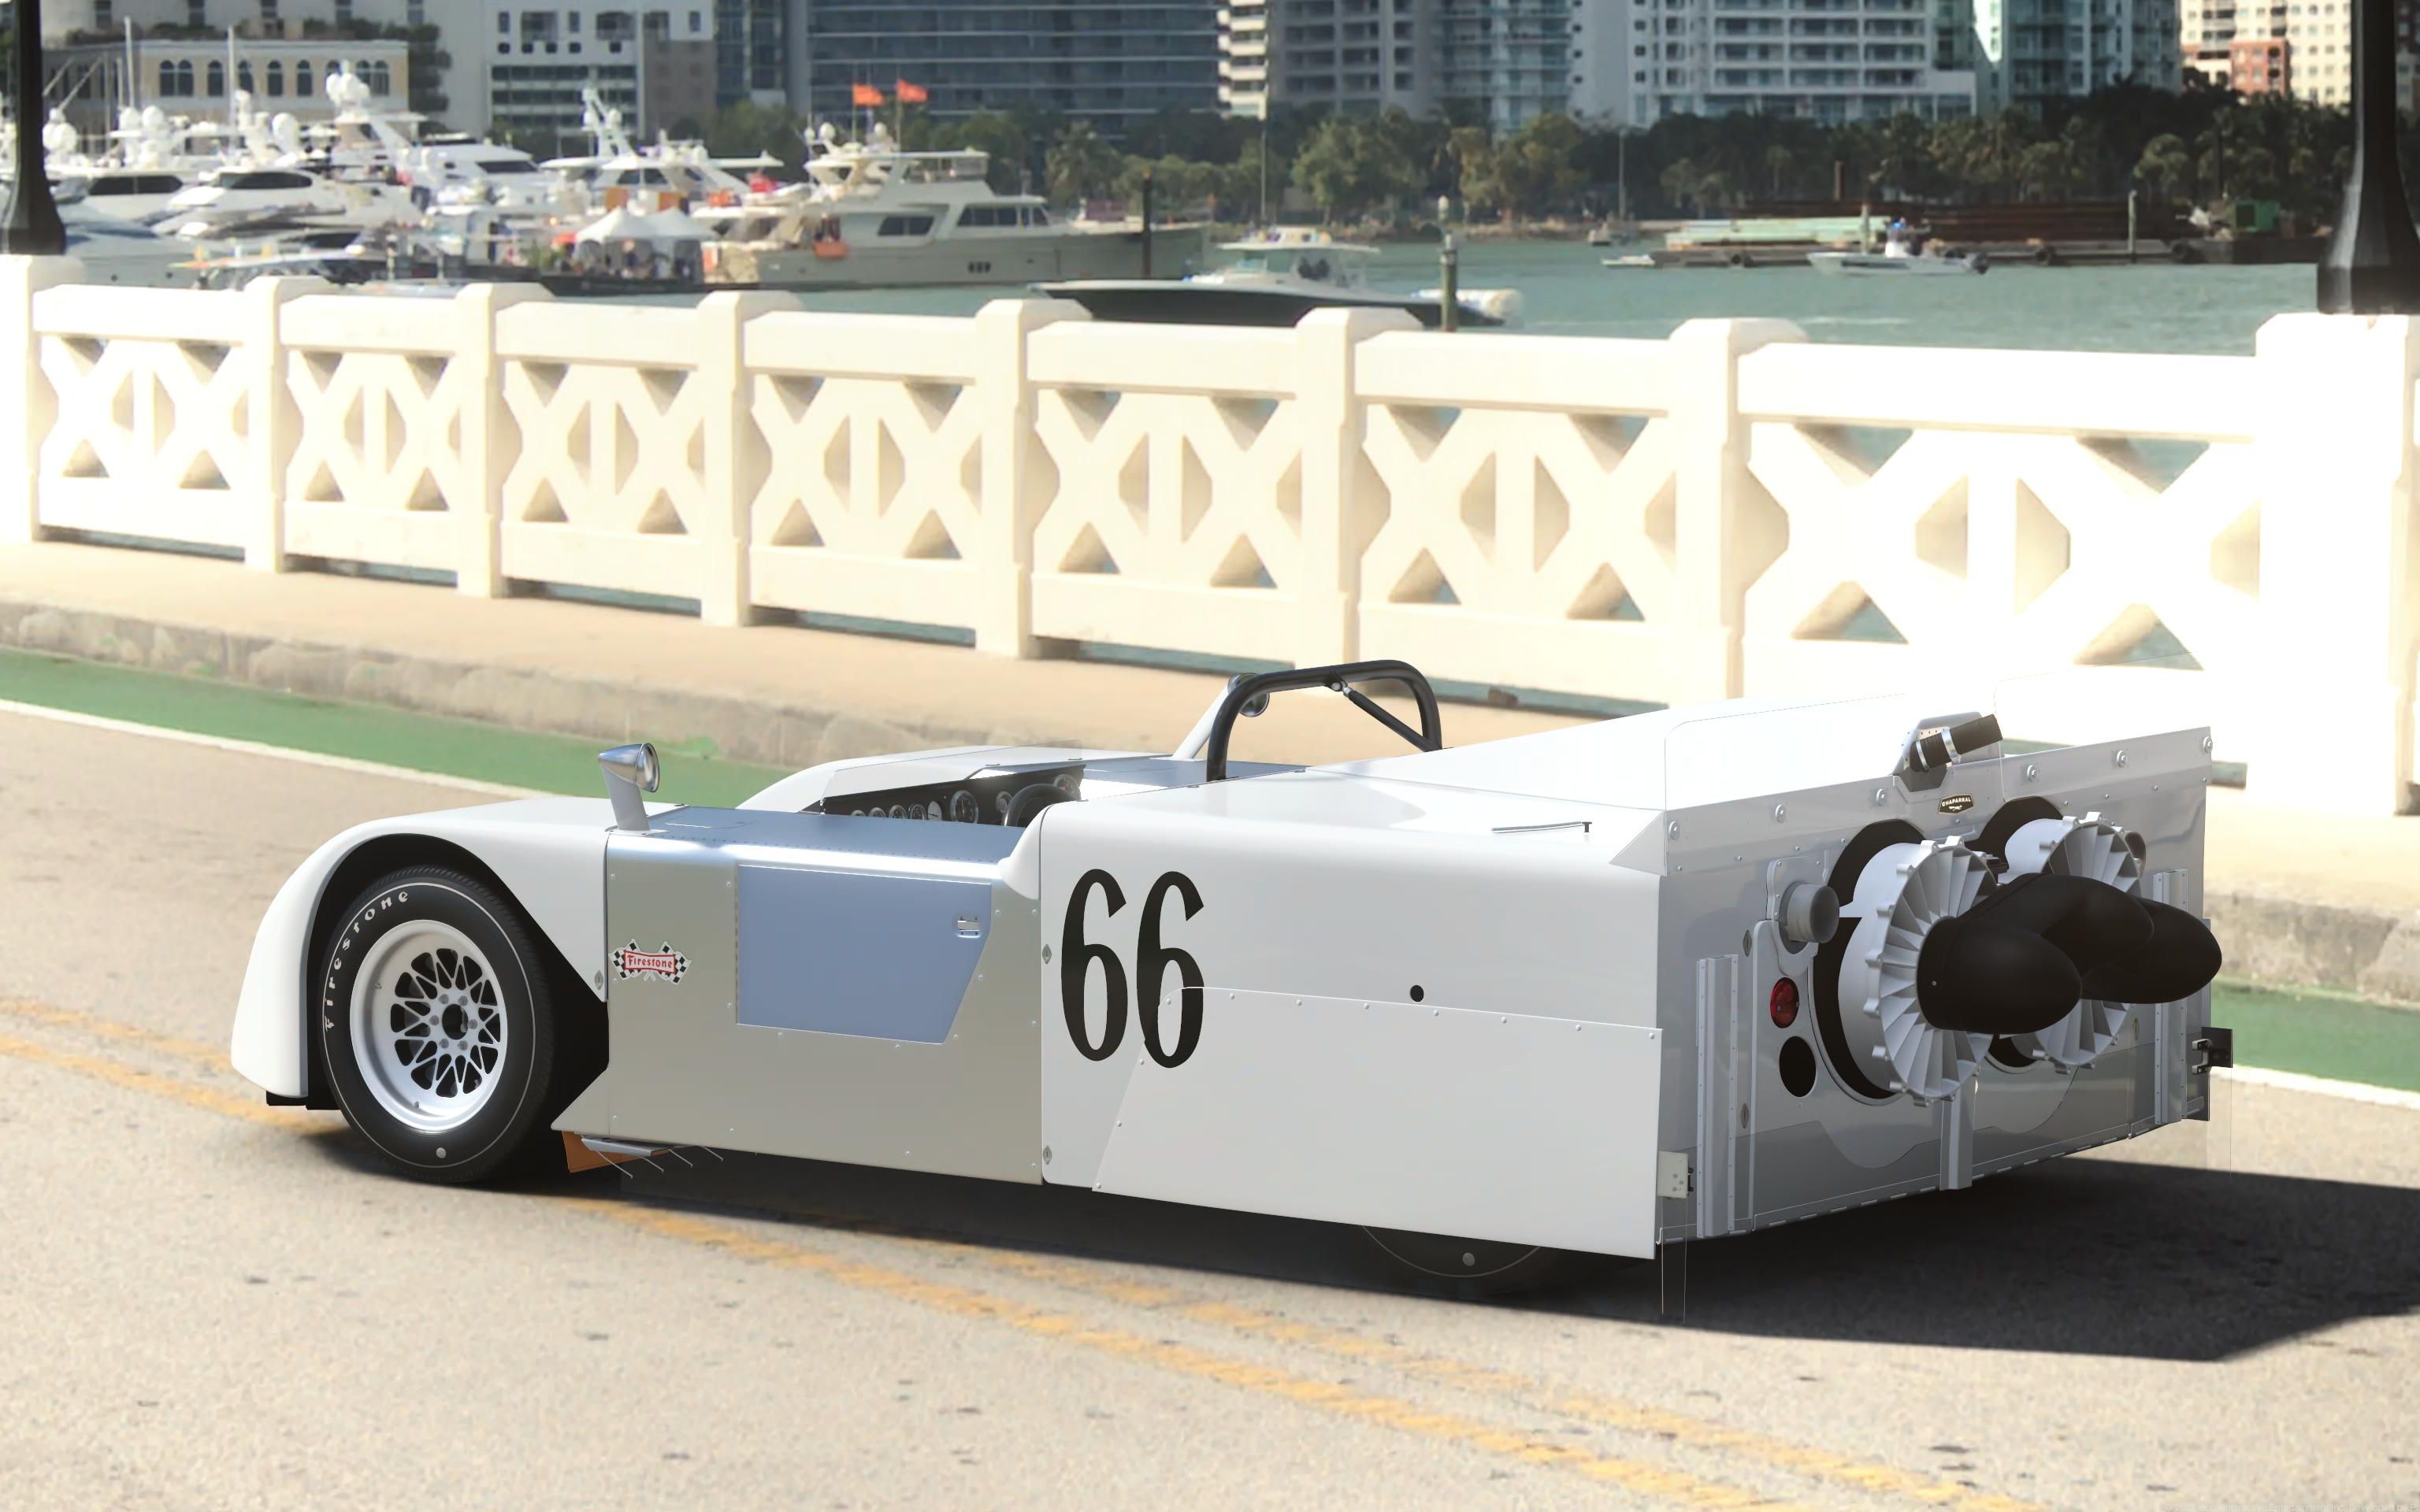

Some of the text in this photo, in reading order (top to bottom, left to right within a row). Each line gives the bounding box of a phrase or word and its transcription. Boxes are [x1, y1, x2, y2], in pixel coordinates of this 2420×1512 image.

[1942, 797, 1971, 806] CHAPARRAL
[325, 891, 409, 1032] Firestone
[628, 955, 673, 968] Firestone
[1061, 869, 1204, 1068] 66
